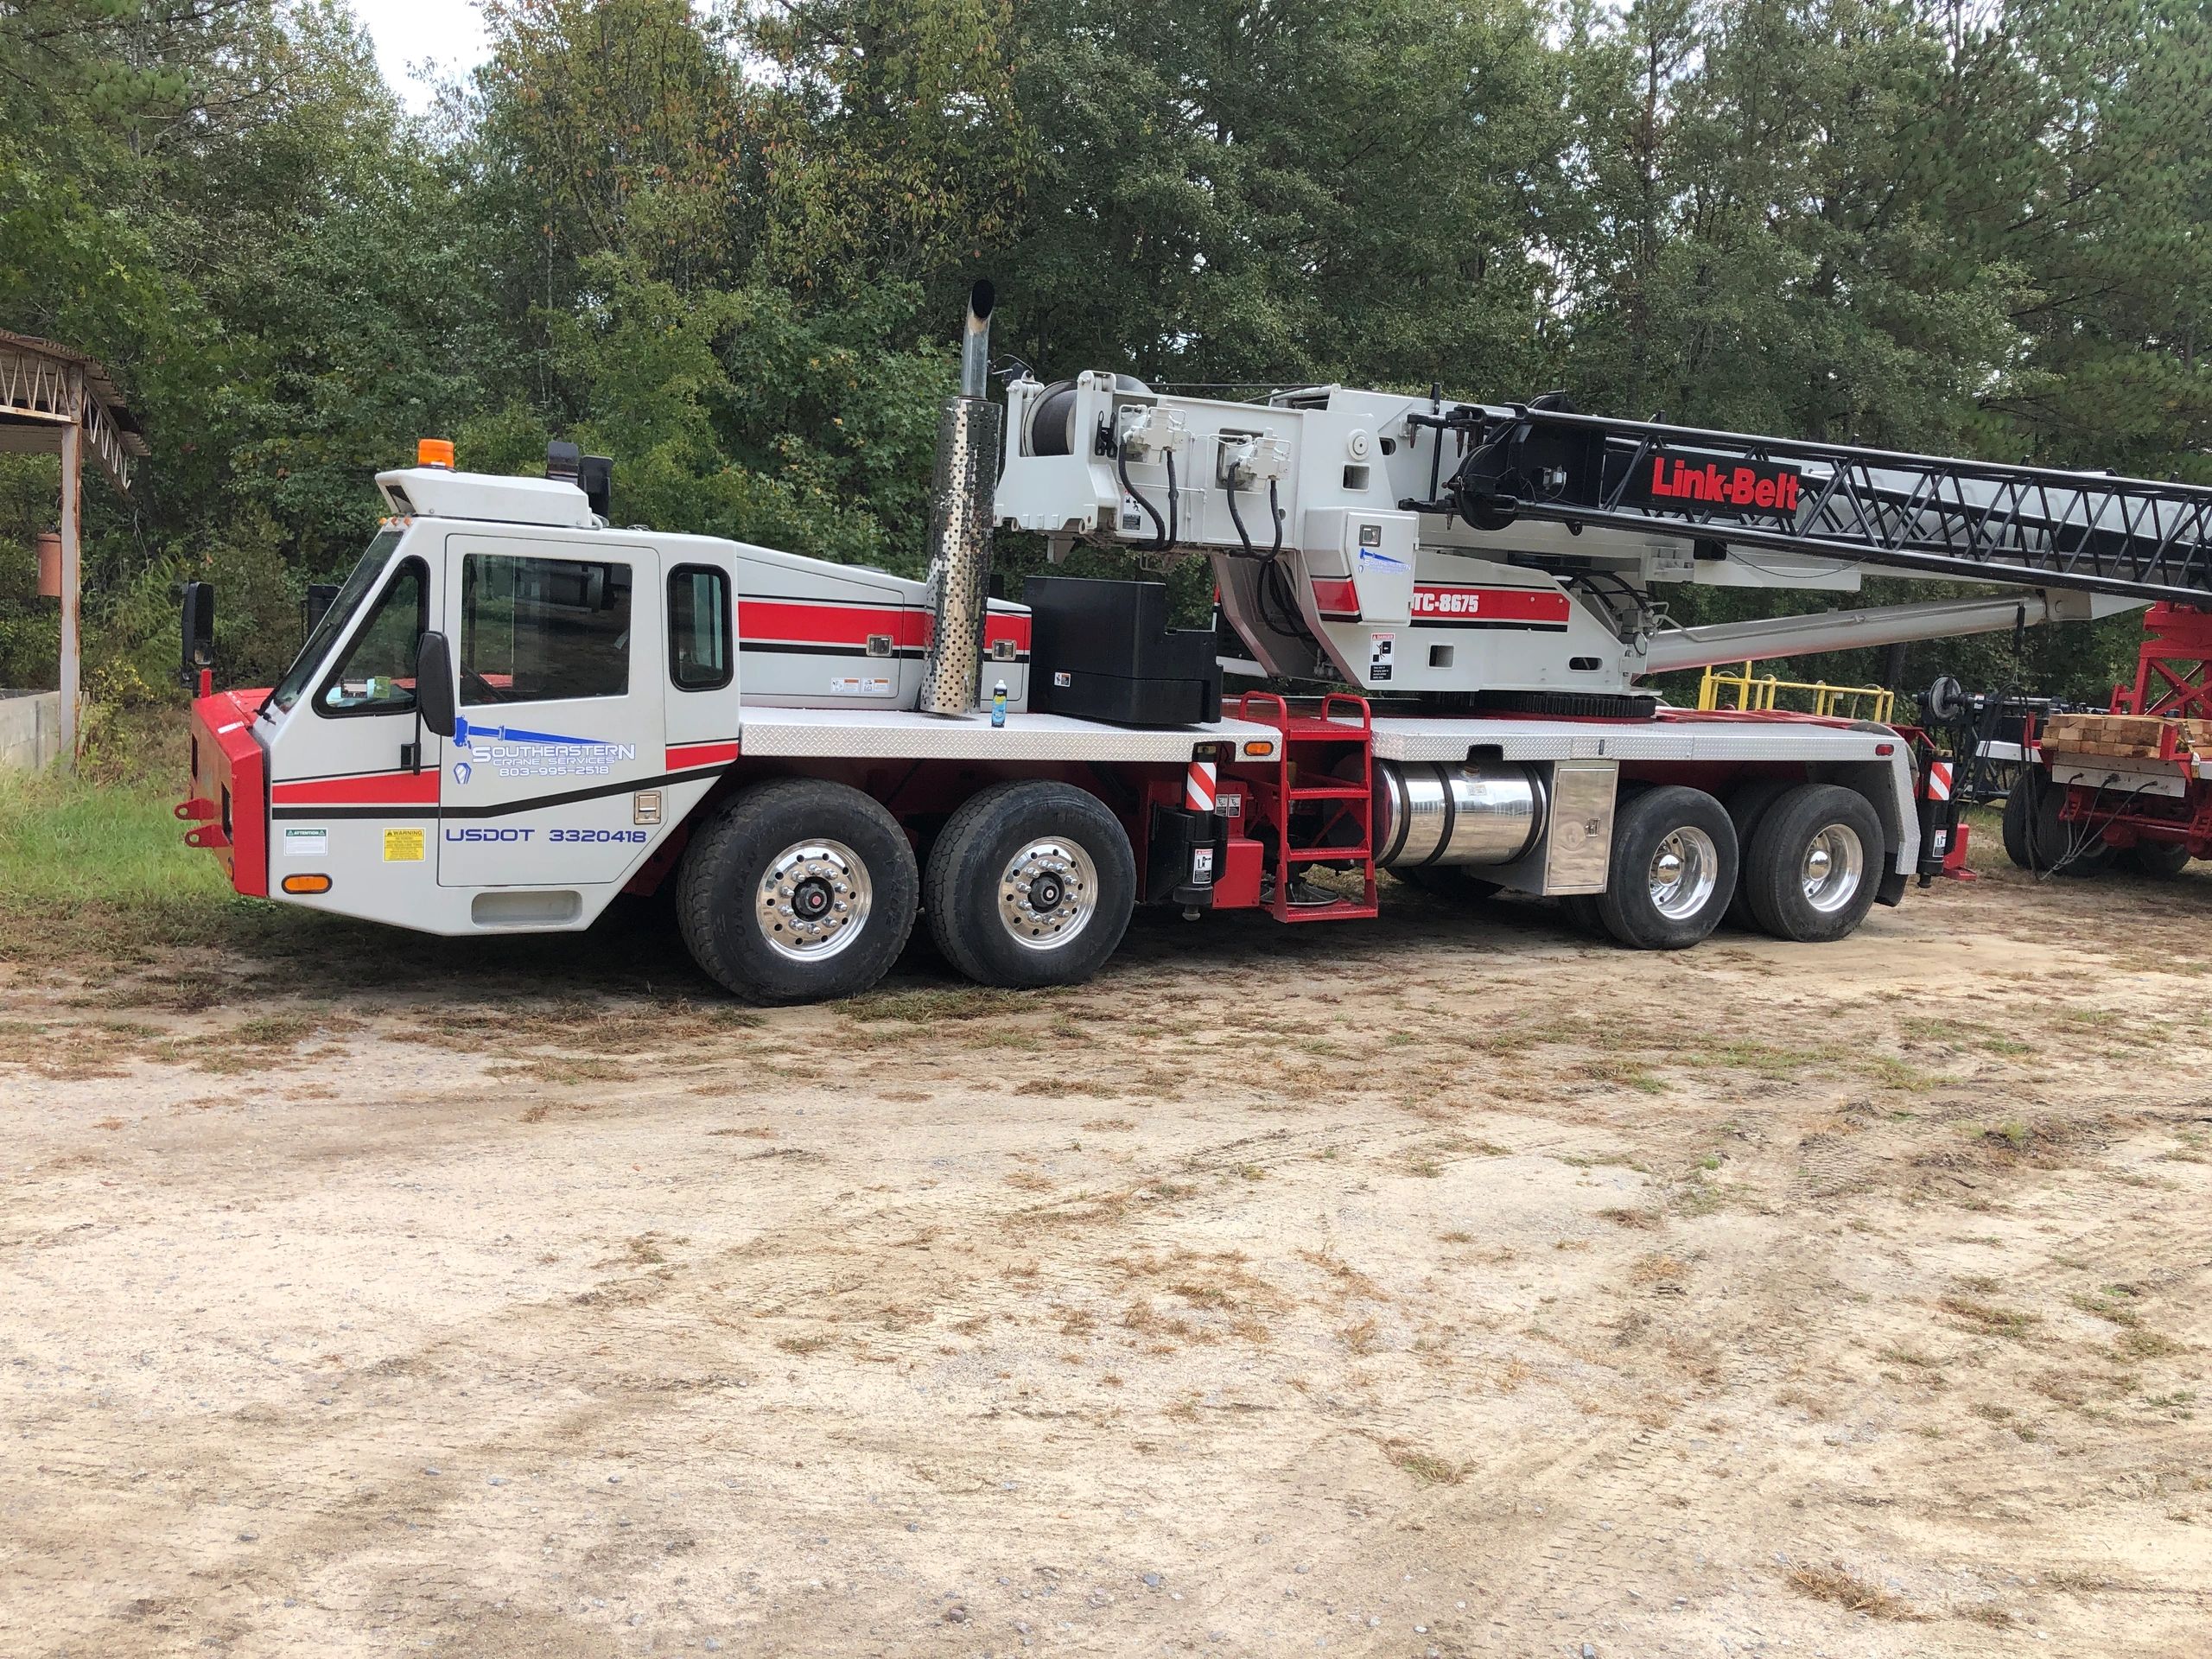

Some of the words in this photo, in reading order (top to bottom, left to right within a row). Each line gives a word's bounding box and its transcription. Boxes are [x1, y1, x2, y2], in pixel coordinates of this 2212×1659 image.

[1652, 457, 1799, 510] Link-Belt
[1413, 592, 1479, 613] TC-8675
[472, 744, 635, 764] SOUTHEASTERN
[493, 758, 540, 766] CRANE
[499, 766, 609, 777] 803-995-2518
[446, 829, 535, 842] USDOT
[549, 830, 646, 842] 3320418
